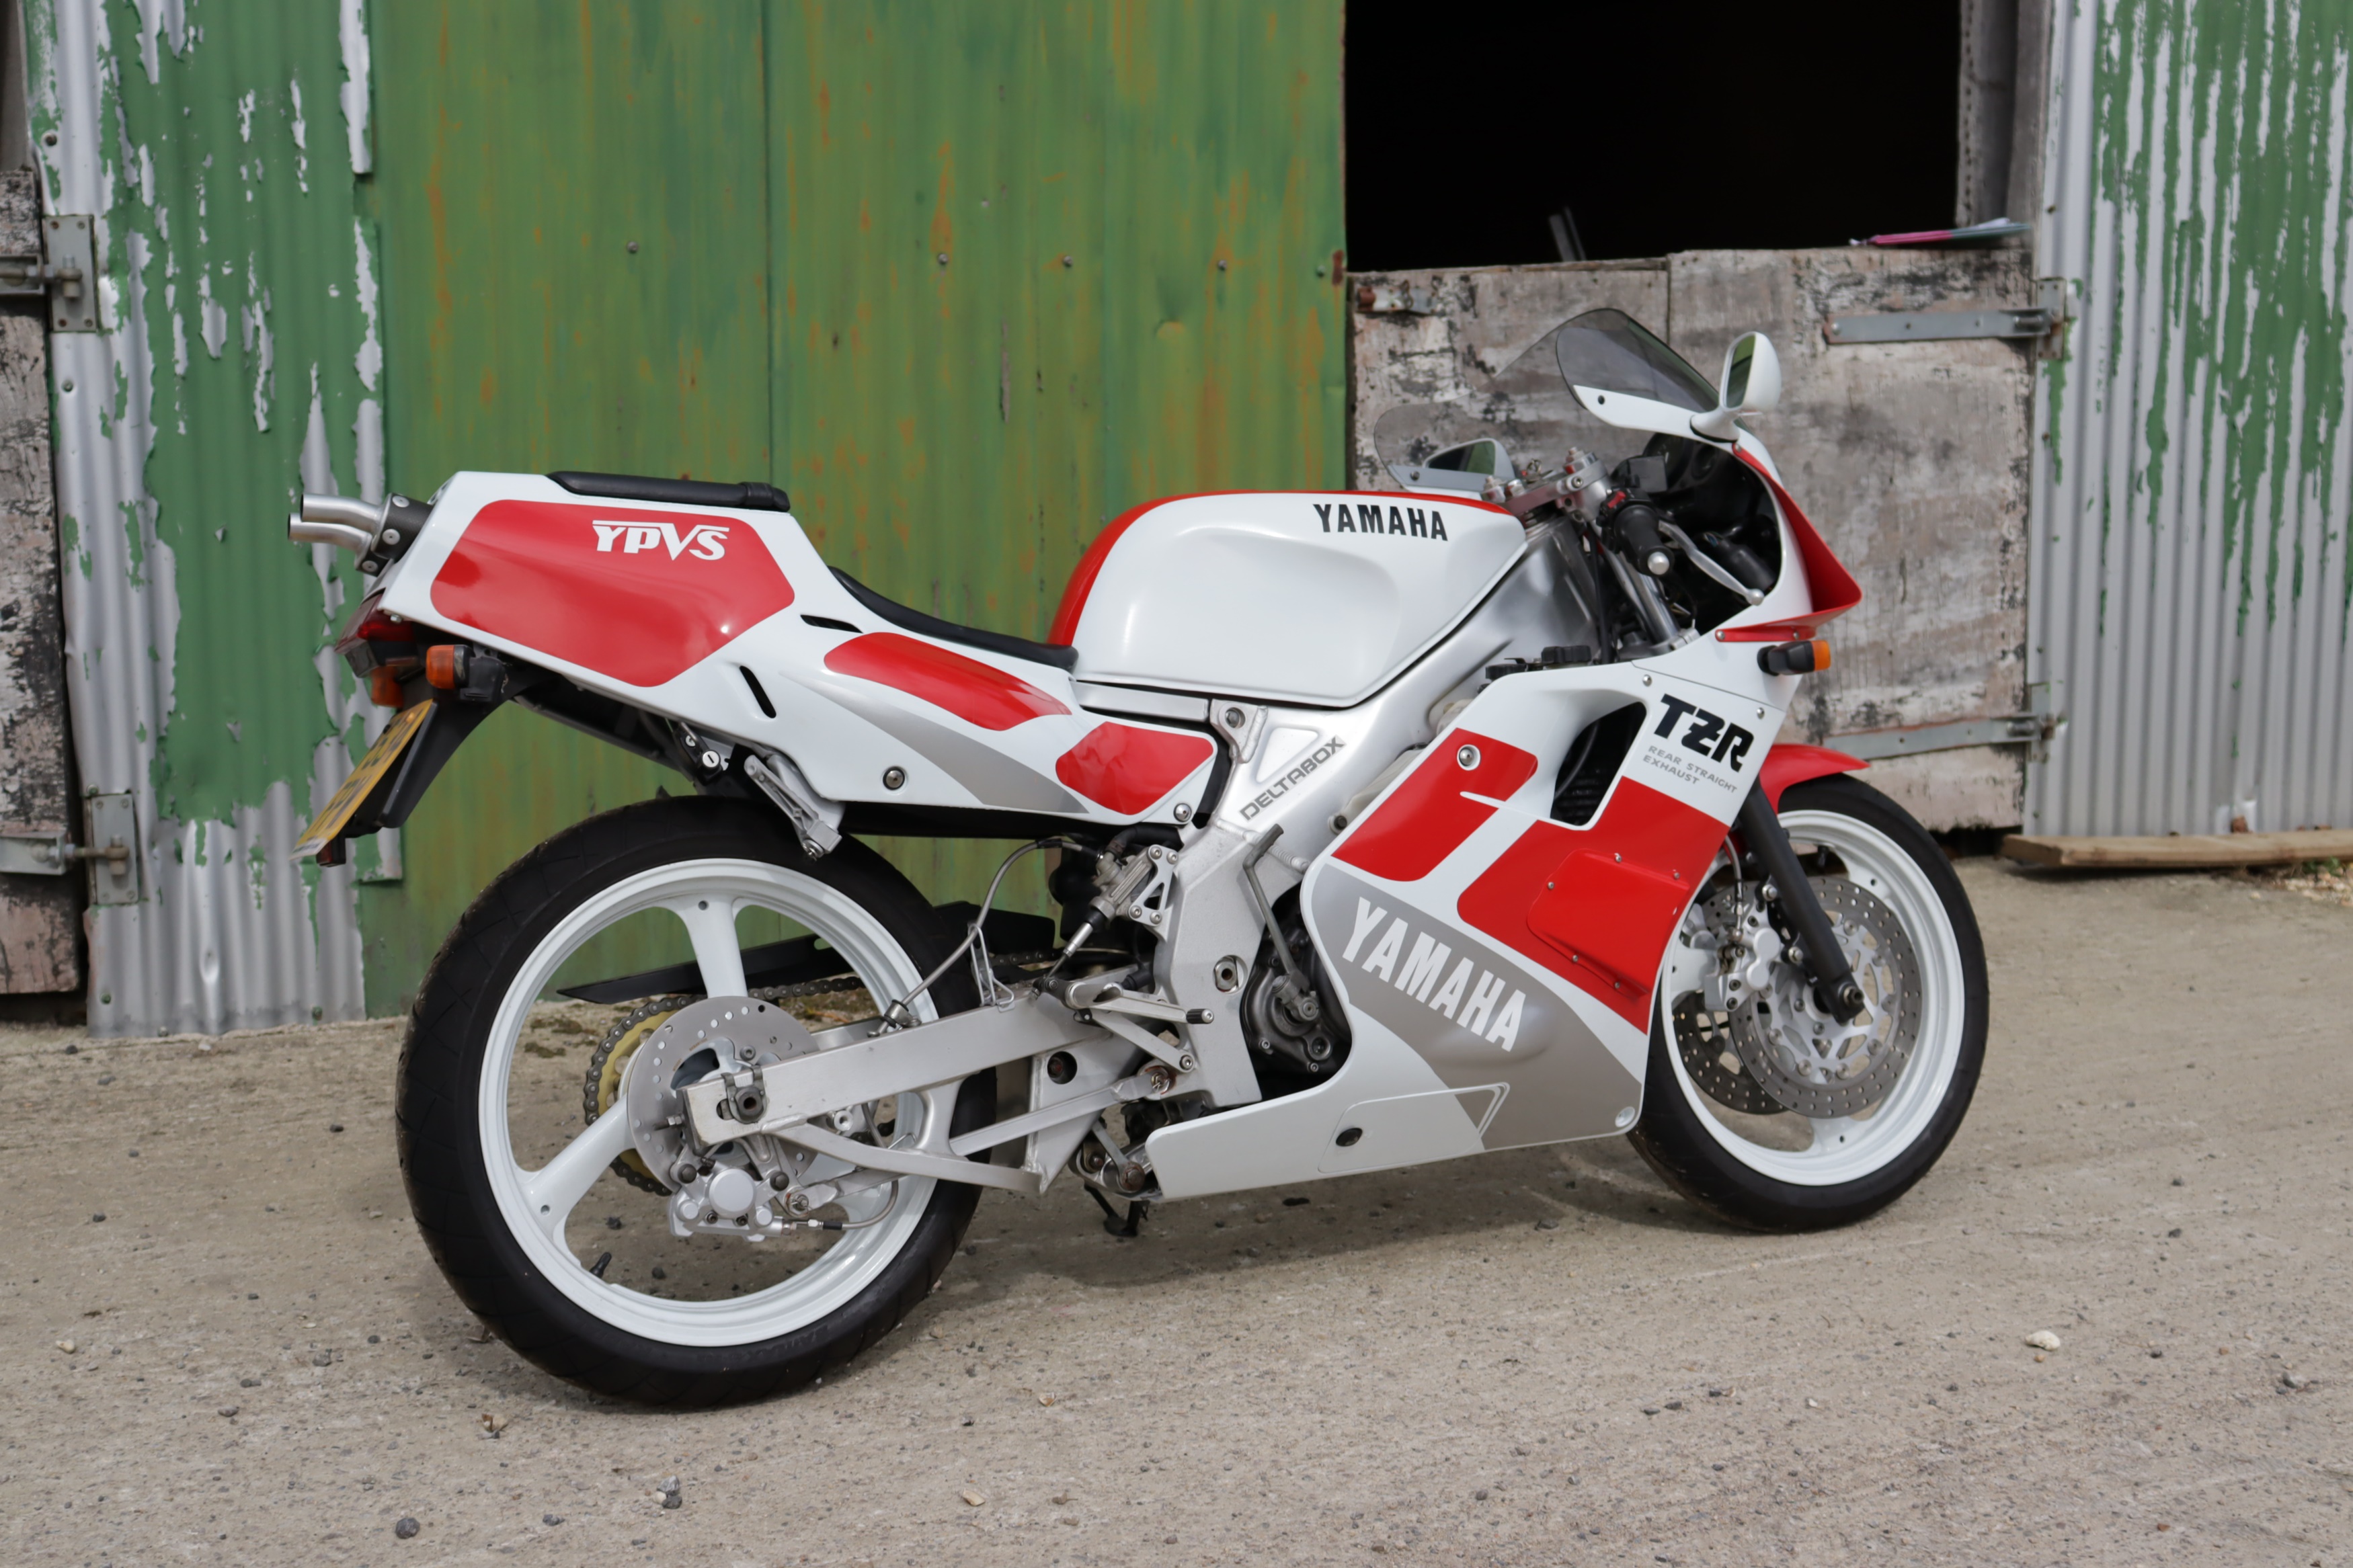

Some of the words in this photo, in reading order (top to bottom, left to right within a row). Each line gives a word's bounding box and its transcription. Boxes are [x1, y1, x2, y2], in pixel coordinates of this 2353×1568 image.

[592, 520, 729, 561] YPVS
[1313, 504, 1448, 541] YAMAHA
[1653, 693, 1754, 773] TZR
[1239, 736, 1345, 821] DELTABOX
[1642, 754, 1700, 785] EXHAUST
[1648, 745, 1682, 766] REAR
[1686, 762, 1737, 794] STRAIGHT
[1342, 896, 1526, 1053] YAMAHA
